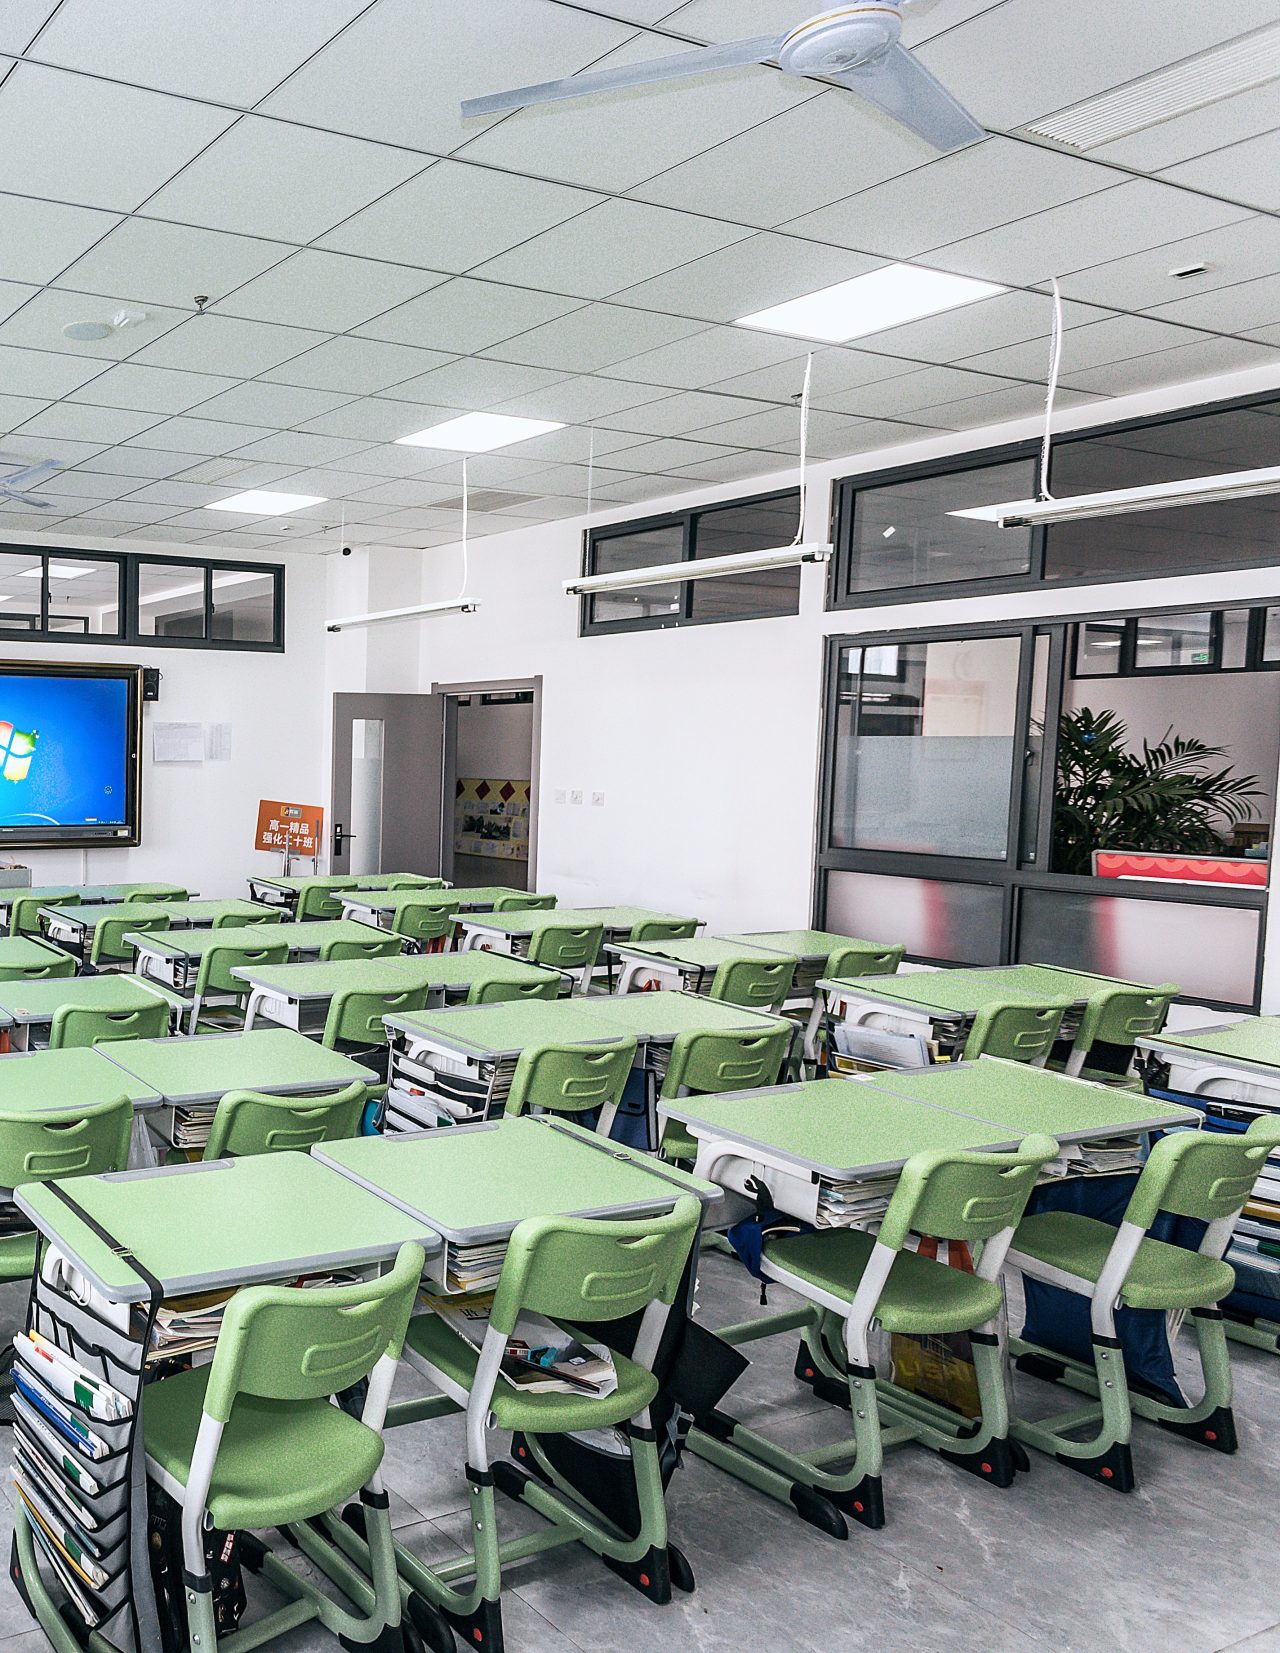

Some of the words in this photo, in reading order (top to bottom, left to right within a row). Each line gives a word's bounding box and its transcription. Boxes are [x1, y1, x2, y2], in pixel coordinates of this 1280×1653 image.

[269, 820, 309, 835] 高一精品
[262, 832, 313, 848] 强化二十班
